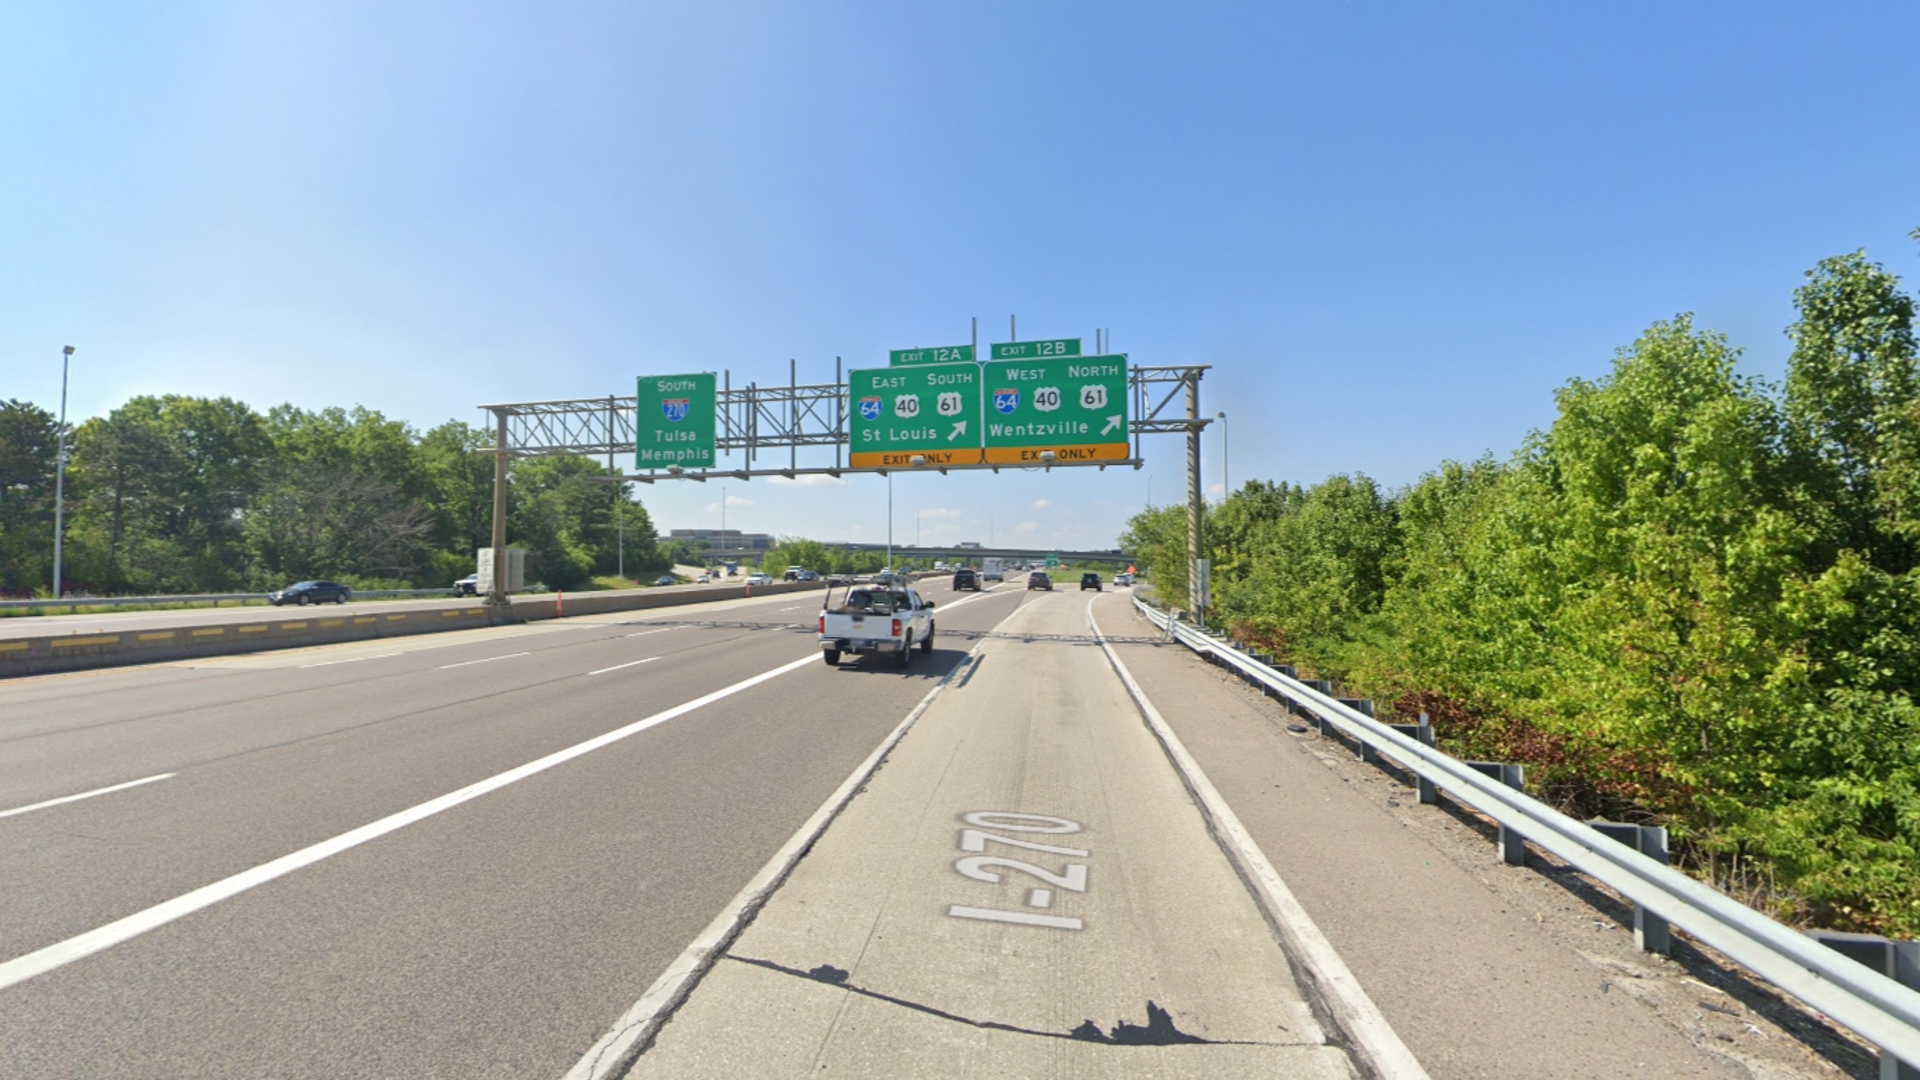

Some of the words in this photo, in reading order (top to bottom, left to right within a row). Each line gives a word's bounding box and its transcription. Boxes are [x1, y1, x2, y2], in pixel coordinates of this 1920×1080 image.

[900, 352, 924, 362] EXIT
[933, 348, 961, 361] 12A
[1001, 346, 1026, 355] EXIT
[1036, 341, 1066, 355] 12B
[1006, 368, 1046, 380] WEST
[1068, 365, 1119, 378] NORTH
[657, 380, 697, 392] SOUTH
[871, 376, 906, 389] EAST
[927, 373, 973, 386] SOUTH
[940, 396, 958, 411] 61
[995, 394, 1017, 409] 64
[1035, 391, 1059, 406] 40
[1084, 389, 1103, 404] 61
[667, 404, 686, 417] 270
[861, 401, 880, 416] 64
[896, 398, 917, 413] 40
[655, 430, 697, 442] Tulsa
[862, 428, 881, 442] St
[889, 427, 937, 441] Louis
[989, 421, 1089, 437] Wentzville
[641, 447, 710, 462] Memphis
[883, 454, 911, 465] EXIT
[919, 453, 953, 464] NLY
[1021, 449, 1053, 461] EX
[1059, 448, 1097, 459] ONLY
